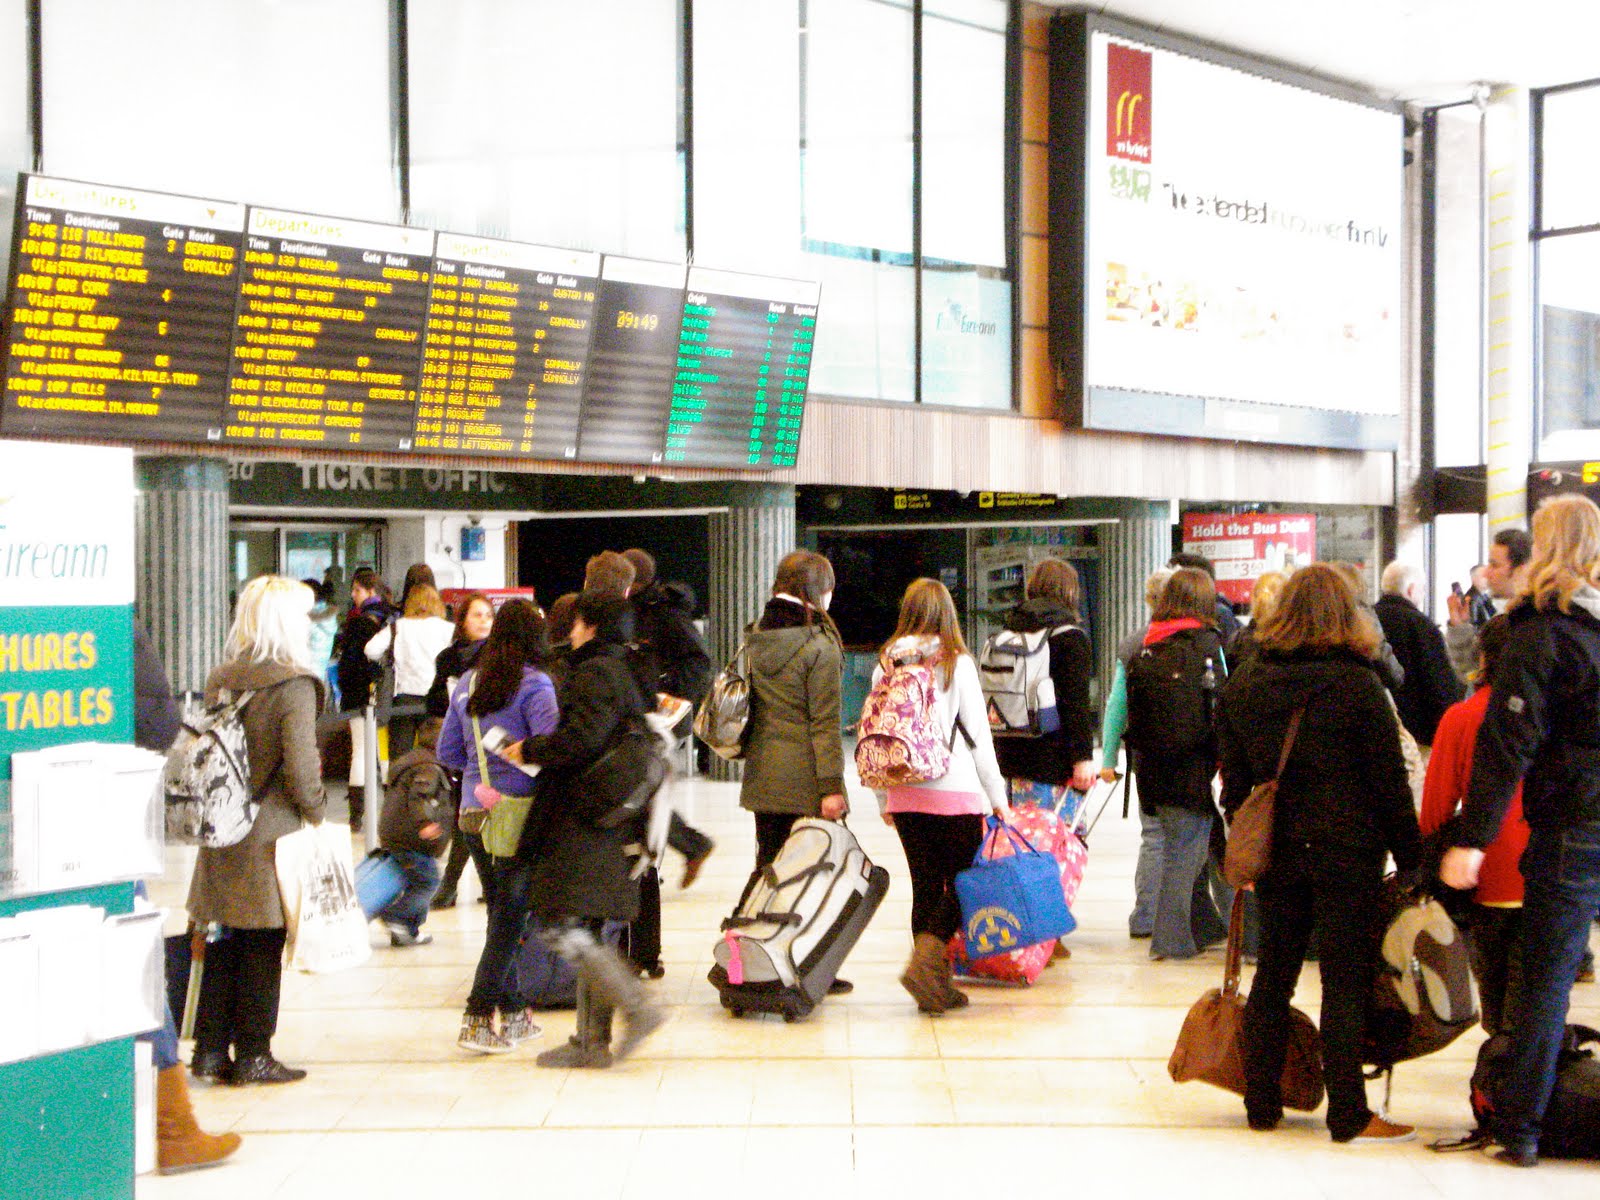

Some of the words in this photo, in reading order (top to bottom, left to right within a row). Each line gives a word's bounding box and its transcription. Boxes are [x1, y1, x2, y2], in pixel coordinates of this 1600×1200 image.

[26, 208, 51, 222] Time
[65, 212, 120, 230] Destination
[163, 226, 185, 240] Gate
[189, 229, 216, 243] Route
[248, 236, 270, 250] Time
[280, 240, 328, 257] Destination
[362, 251, 382, 265] Gate
[385, 254, 409, 268] Route
[436, 260, 456, 274] Time
[464, 264, 506, 280] Destination
[536, 272, 554, 286] Gate
[549, 316, 588, 330] CONNOLLY
[375, 328, 418, 342] CONNOLLY
[266, 348, 298, 362] DERRY
[532, 343, 540, 354] 2
[544, 358, 582, 372] CONNOLLY
[542, 371, 580, 385] CONNOLLY
[527, 383, 536, 396] 7
[326, 399, 350, 412] TOUR
[324, 415, 364, 429] GARDENS
[422, 468, 507, 493] OFFIC
[1192, 524, 1224, 538] Hold
[1227, 523, 1250, 536] the
[1253, 521, 1277, 535] Bus
[0, 541, 109, 579] ireann
[2, 687, 114, 731] TABLES
